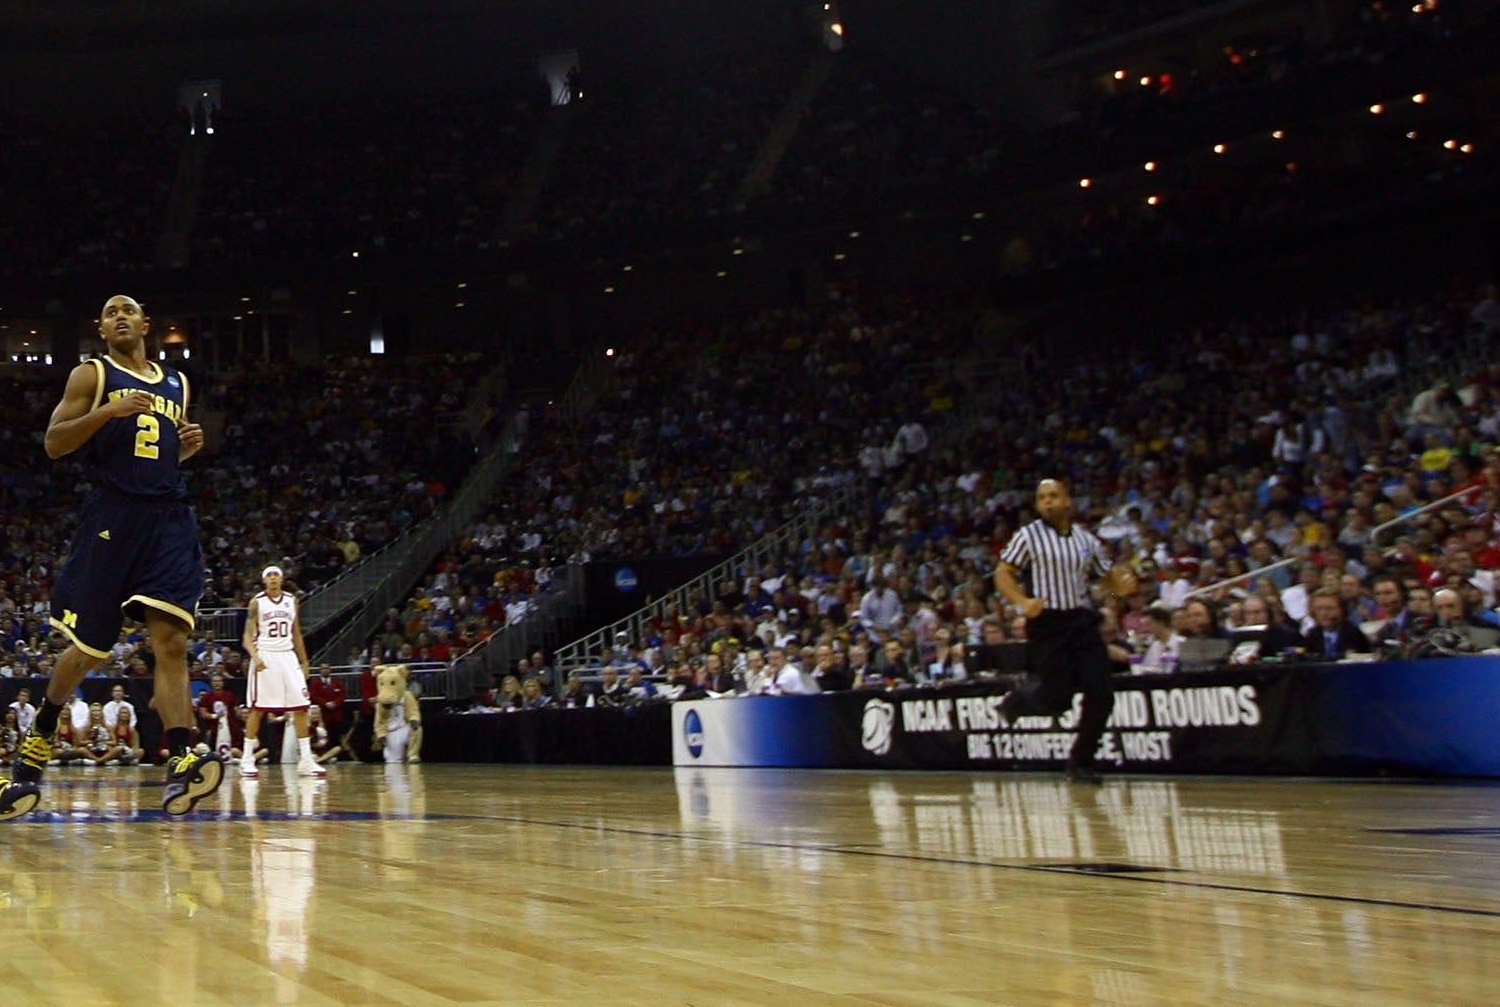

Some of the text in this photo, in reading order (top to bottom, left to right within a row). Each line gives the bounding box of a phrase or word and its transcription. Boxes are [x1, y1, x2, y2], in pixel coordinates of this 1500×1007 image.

[134, 414, 160, 460] 2
[63, 609, 78, 629] M
[268, 621, 288, 638] 20
[1151, 685, 1260, 728] ROUNDS
[967, 734, 991, 759] BIG
[992, 734, 1013, 759] 12
[1121, 731, 1171, 761] HOST
